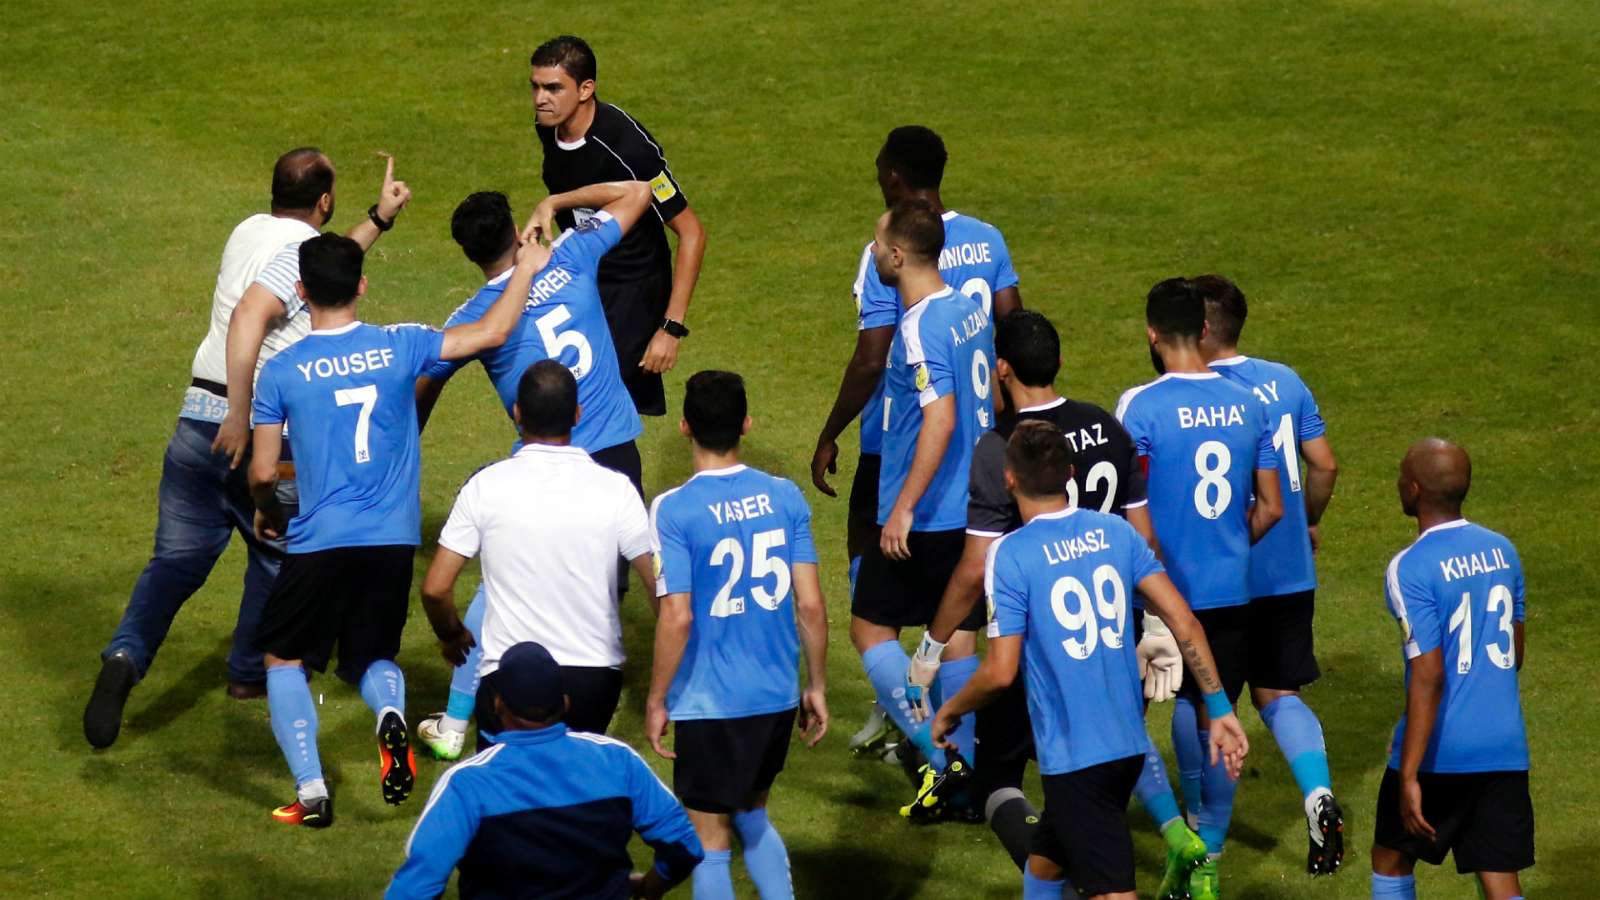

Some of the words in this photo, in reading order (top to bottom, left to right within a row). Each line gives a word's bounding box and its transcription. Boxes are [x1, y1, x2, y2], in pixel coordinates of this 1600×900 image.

[297, 348, 394, 382] YOUSEF
[534, 303, 593, 380] 5
[334, 384, 378, 464] 7
[1064, 423, 1109, 453] TAZ
[1177, 404, 1246, 429] BAHA'
[1194, 440, 1232, 520] 8
[708, 494, 774, 524] YASER
[709, 528, 791, 618] 25
[1042, 528, 1110, 565] LUKASZ
[1439, 548, 1510, 582] KHALIL
[1051, 564, 1127, 661] 99
[1448, 584, 1515, 674] 13
